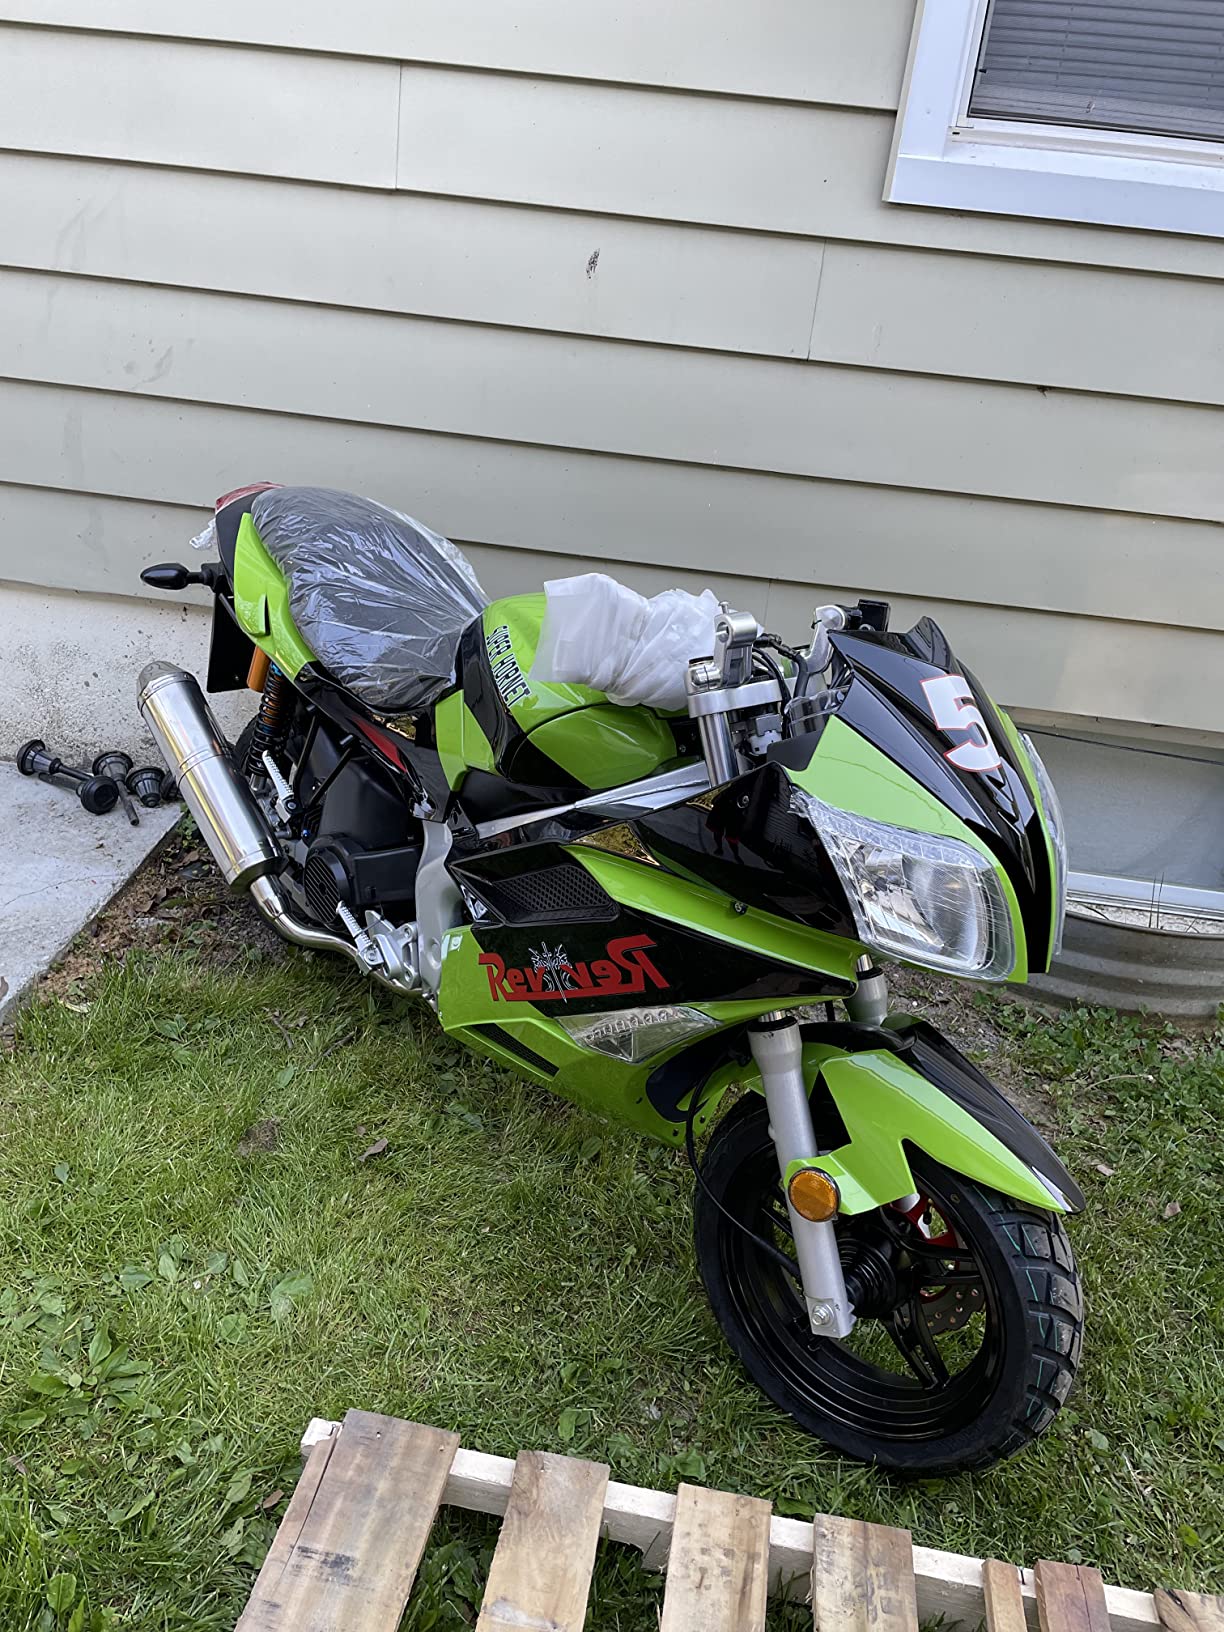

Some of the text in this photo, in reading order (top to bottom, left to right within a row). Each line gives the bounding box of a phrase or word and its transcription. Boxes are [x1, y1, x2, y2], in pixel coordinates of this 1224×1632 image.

[486, 624, 531, 707] SUPER HORNET
[920, 674, 1001, 771] 5
